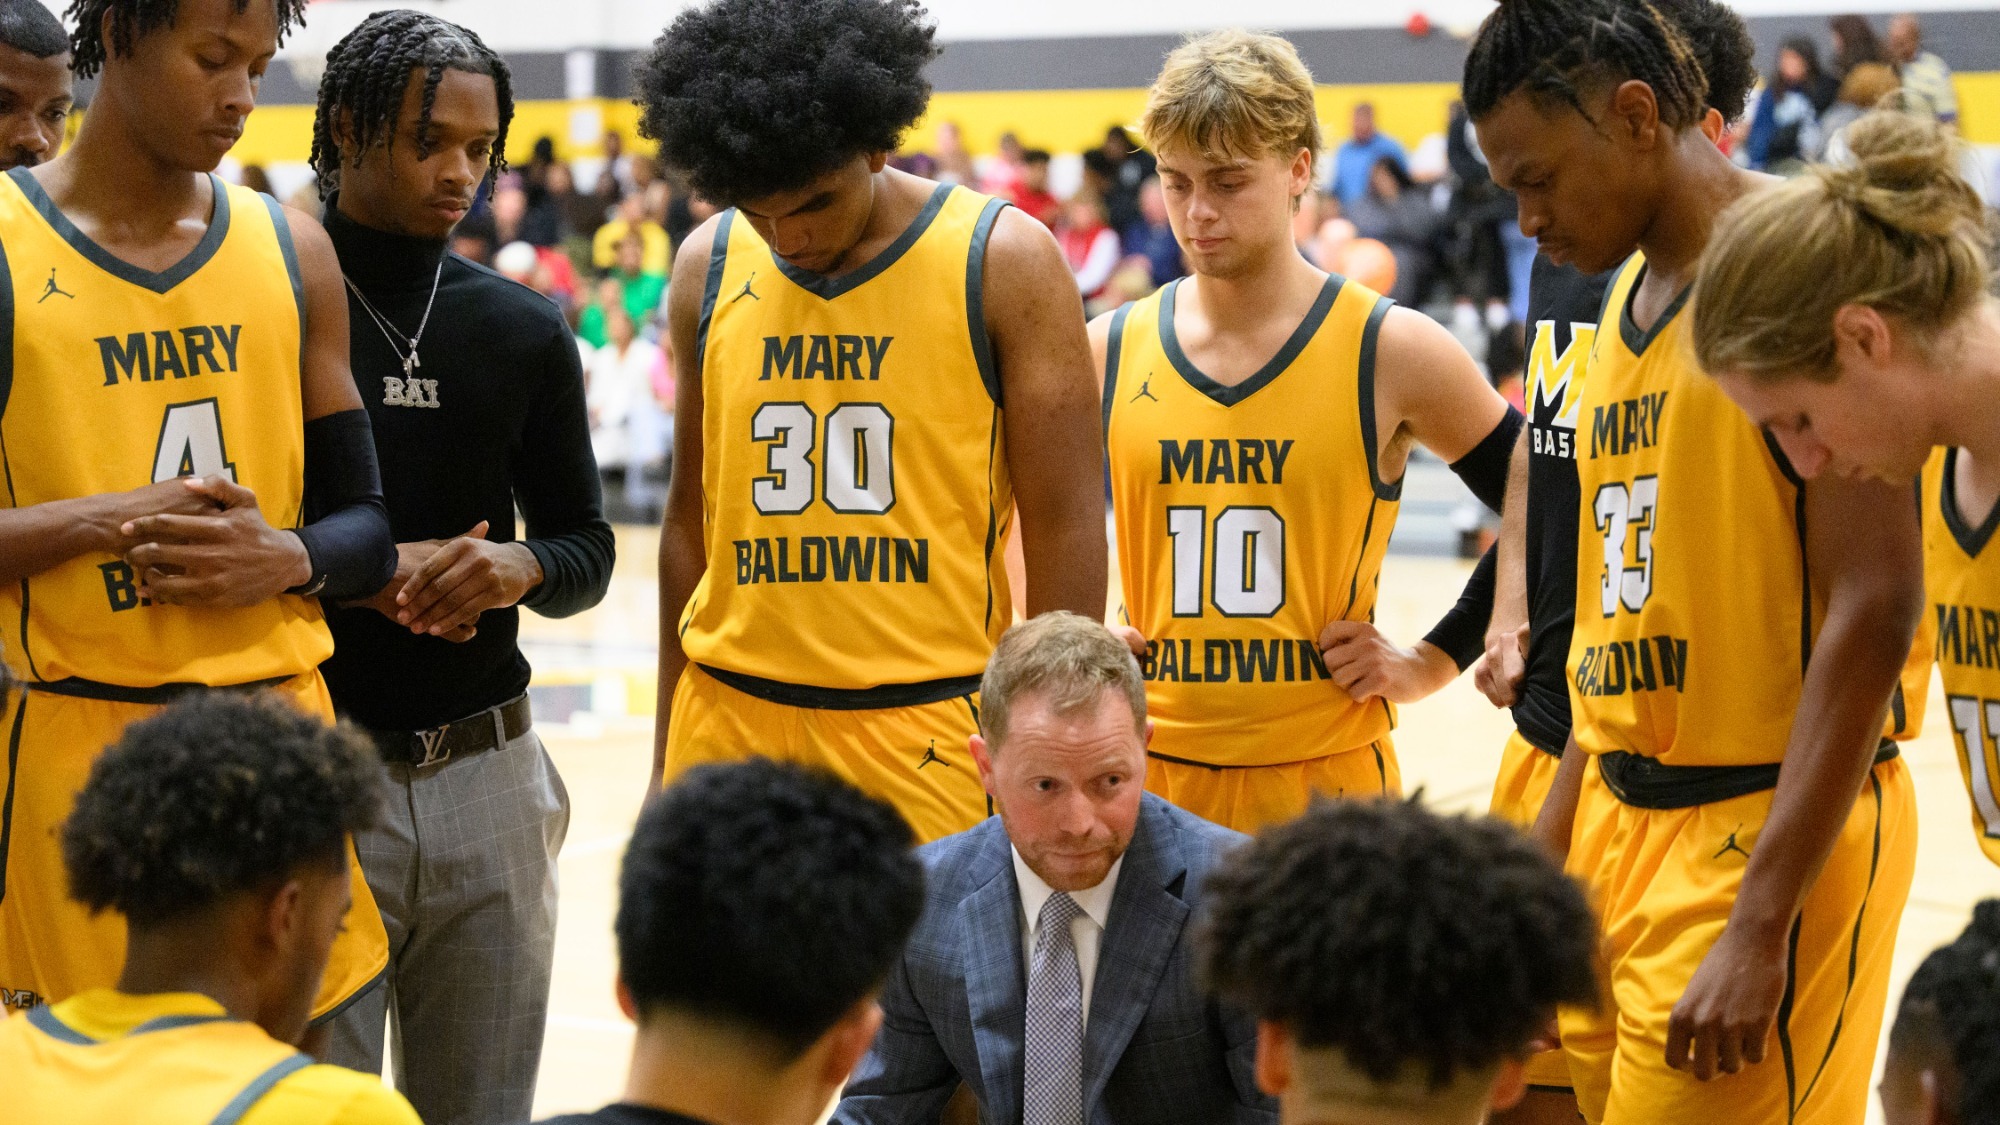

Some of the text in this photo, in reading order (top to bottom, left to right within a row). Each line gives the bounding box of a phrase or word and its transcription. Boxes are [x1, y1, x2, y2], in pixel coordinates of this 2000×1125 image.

[94, 323, 242, 386] MARY
[758, 335, 894, 381] MARY
[151, 396, 239, 484] 4
[1532, 428, 1577, 461] BAS
[1590, 390, 1668, 460] MARY
[751, 401, 895, 515] 30
[1158, 439, 1295, 485] MARY
[731, 536, 929, 586] BALDWIN
[1167, 505, 1286, 618] 10
[1592, 473, 1659, 618] 33
[1142, 638, 1333, 683] BALDWIN
